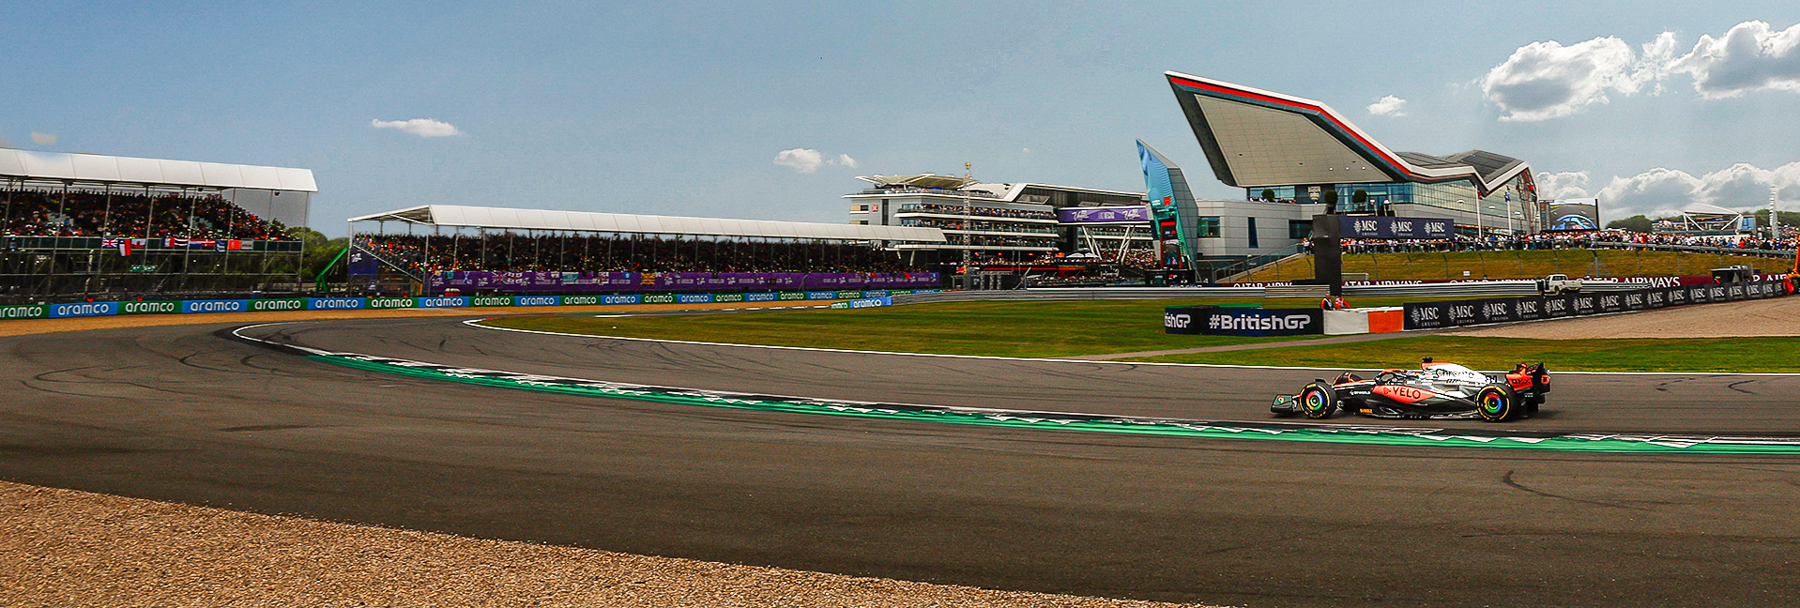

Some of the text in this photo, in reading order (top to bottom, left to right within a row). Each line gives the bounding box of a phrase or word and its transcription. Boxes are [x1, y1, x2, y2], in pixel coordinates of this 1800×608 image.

[1361, 220, 1378, 232] MSC
[1397, 221, 1413, 232] MSC
[1430, 222, 1446, 233] MSC
[474, 297, 511, 306] aramco
[520, 296, 555, 305] aramco
[564, 296, 597, 305] aramco
[605, 295, 636, 304] aramco
[644, 294, 674, 303] aramco
[681, 294, 709, 303] aramco
[716, 293, 742, 302] aramco
[749, 293, 774, 301] aramco
[780, 292, 804, 300] aramco
[1605, 295, 1620, 307] MSC
[1629, 293, 1643, 305] MSC
[125, 301, 175, 312] aramco
[190, 300, 240, 311] aramco
[254, 299, 301, 310] aramco
[315, 299, 359, 308] aramco
[371, 298, 413, 308] aramco
[425, 297, 464, 307] aramco
[1521, 301, 1538, 313] MSC
[1550, 298, 1566, 311] MSC
[1579, 296, 1594, 309] MSC
[0, 306, 43, 318] ramco
[57, 303, 110, 316] aramco
[1420, 307, 1440, 320] MSC
[1455, 305, 1475, 318] MSC
[1490, 302, 1508, 316] MSC
[1209, 314, 1311, 330] #BritishGP
[1392, 386, 1421, 399] VELO
